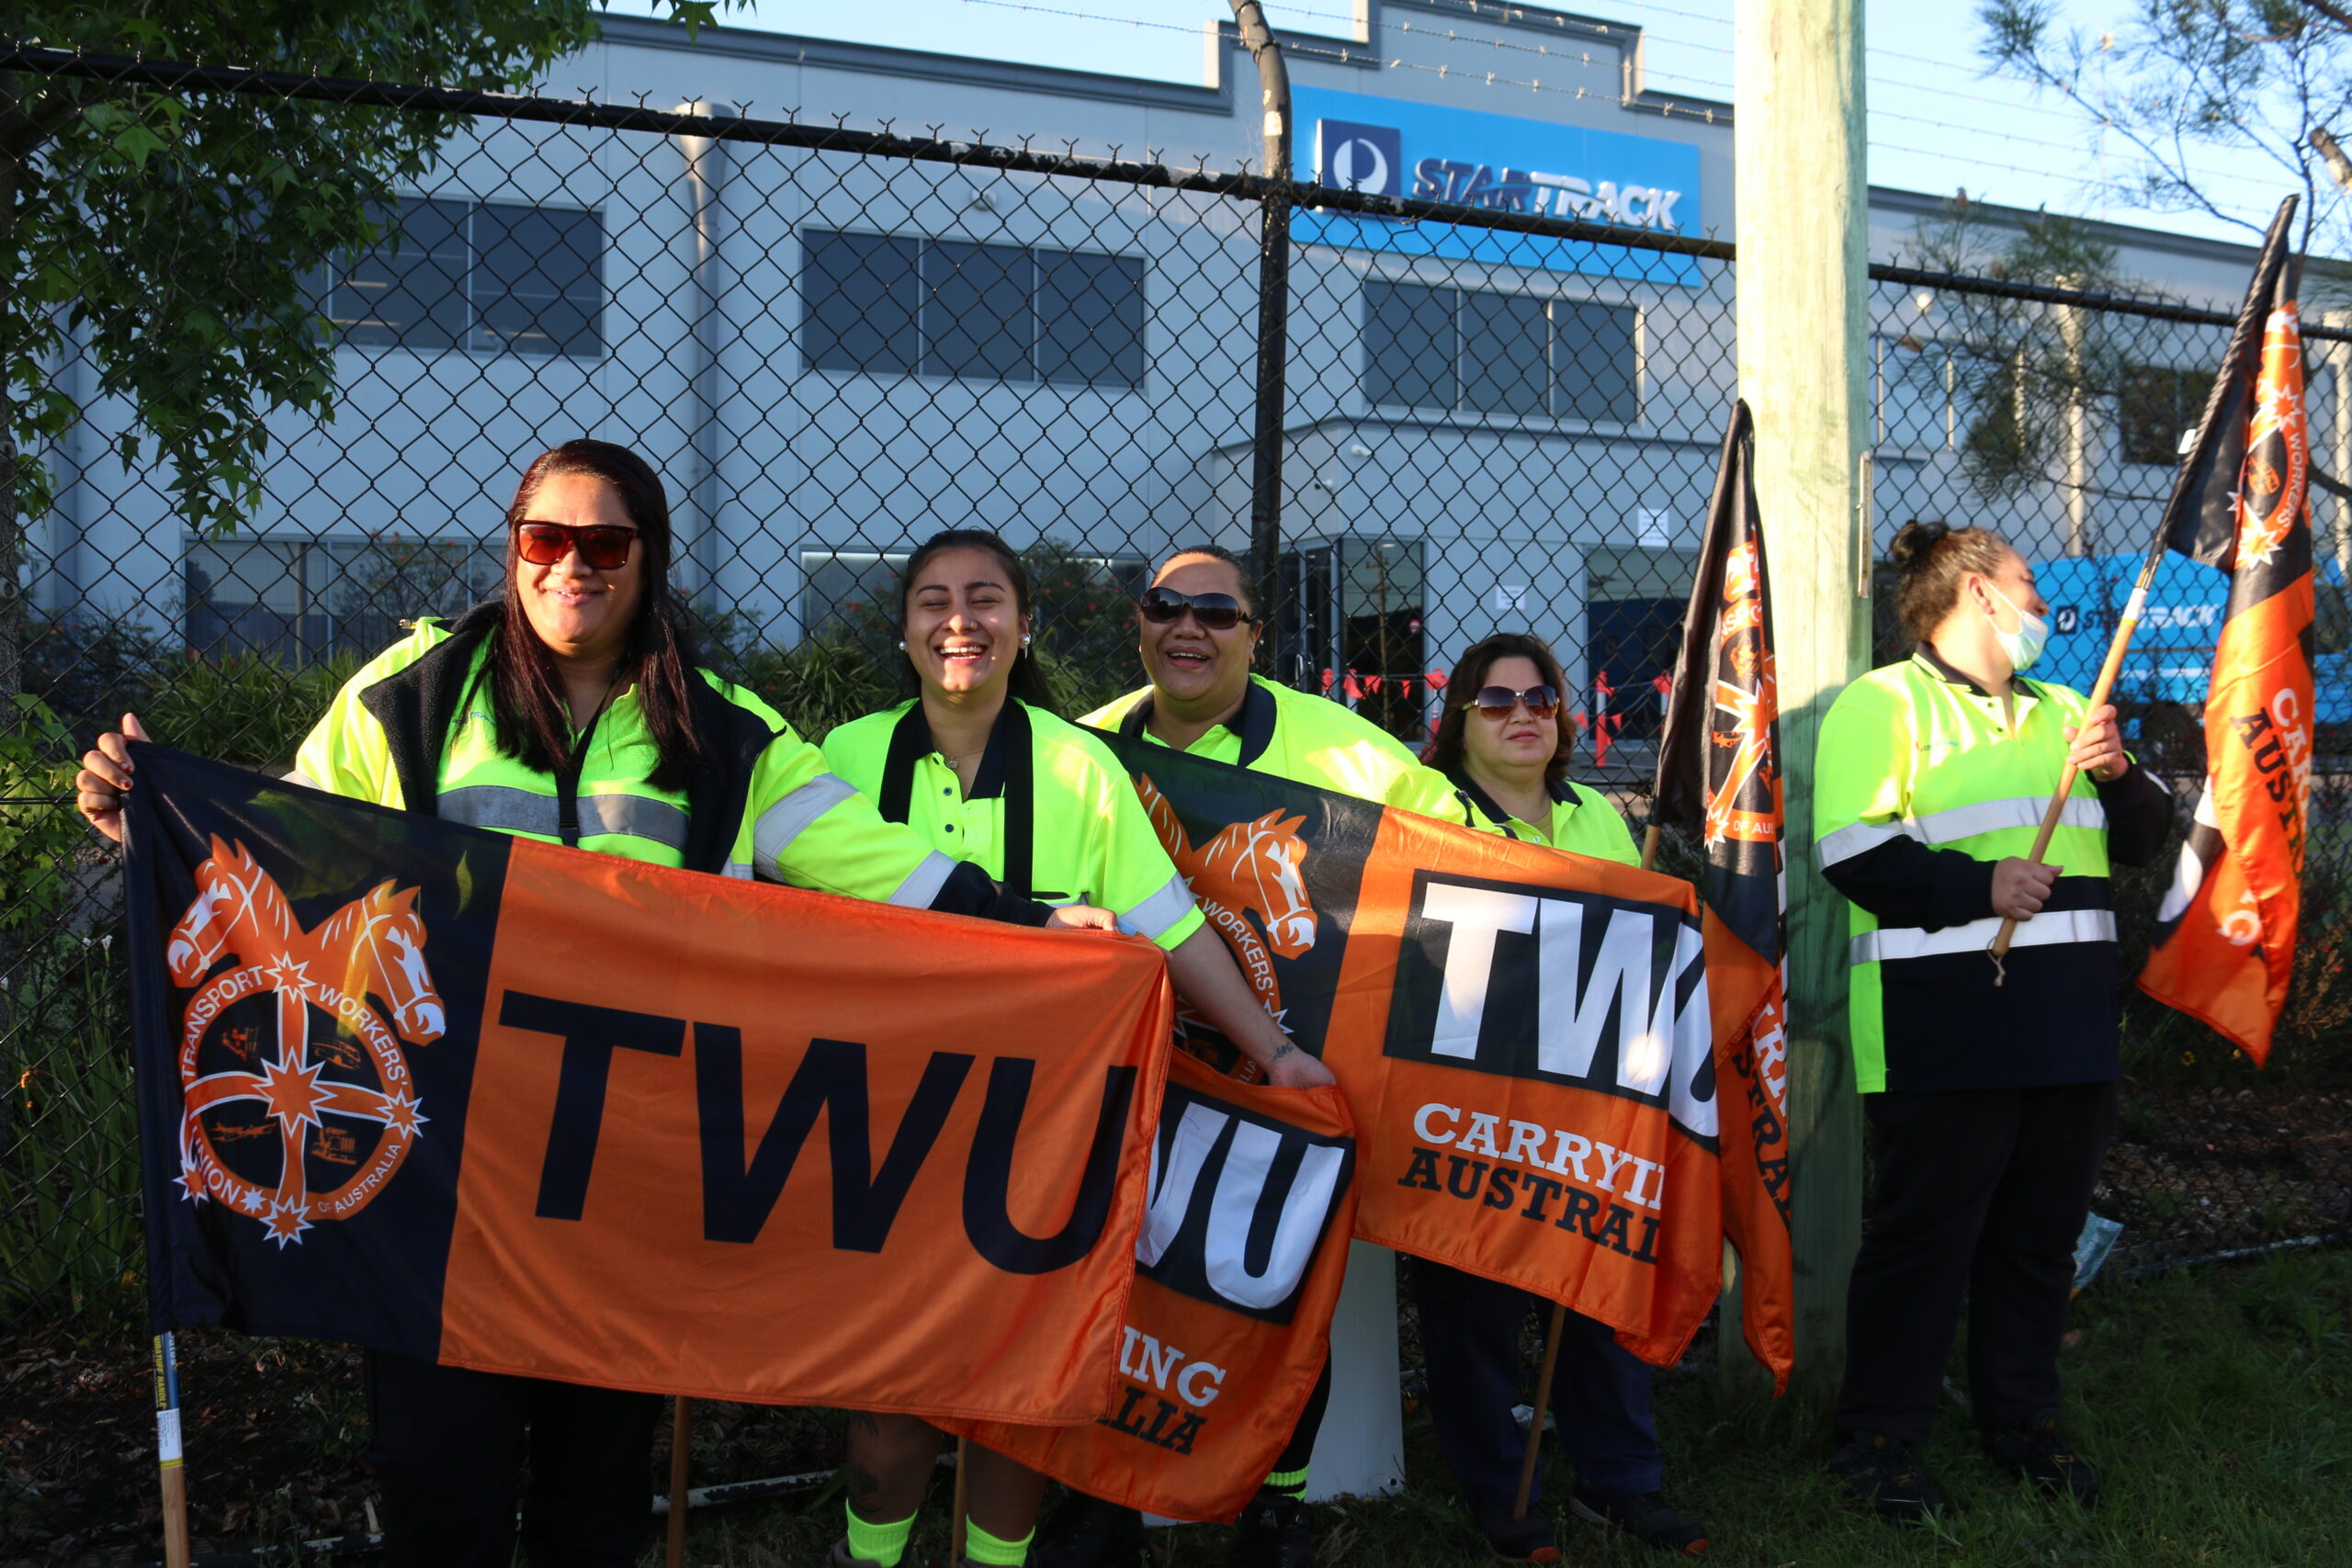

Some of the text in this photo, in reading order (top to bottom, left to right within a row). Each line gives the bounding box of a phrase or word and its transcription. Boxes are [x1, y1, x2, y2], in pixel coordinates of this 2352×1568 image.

[1202, 897, 1275, 997] WORKERS'
[181, 965, 264, 1079] TRANSPORT
[319, 983, 409, 1086] WORKERS'
[334, 1145, 401, 1213] AUSTRALIA
[498, 988, 1138, 1275] TWU
